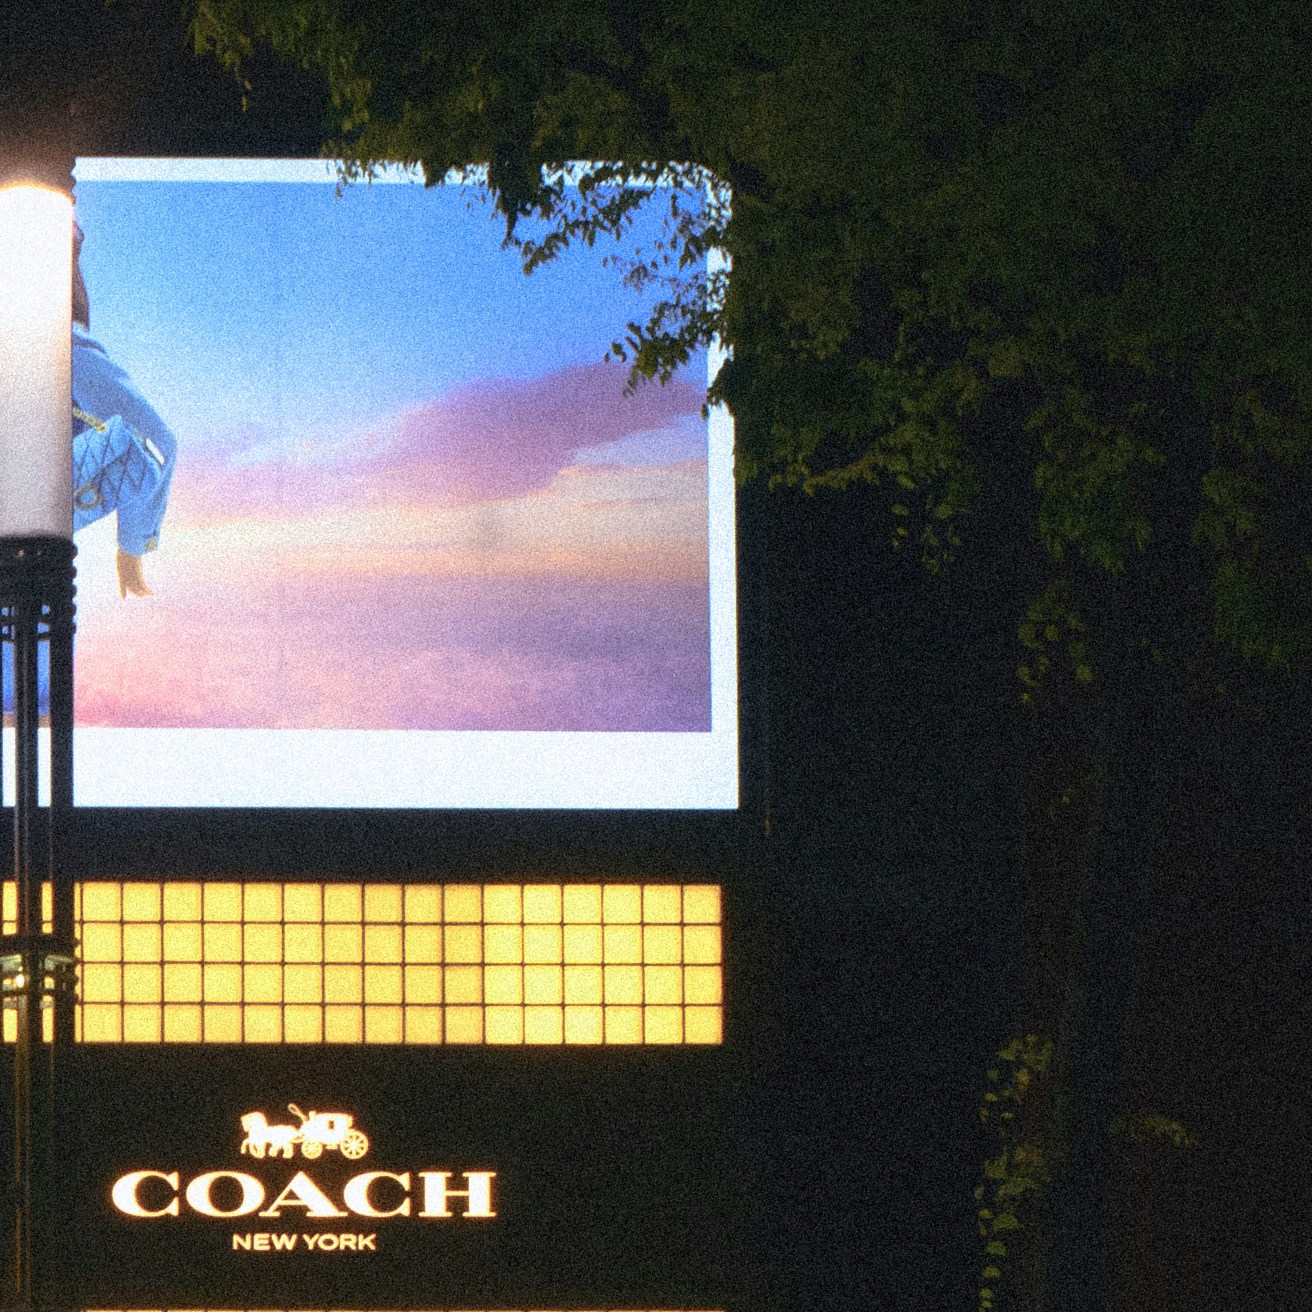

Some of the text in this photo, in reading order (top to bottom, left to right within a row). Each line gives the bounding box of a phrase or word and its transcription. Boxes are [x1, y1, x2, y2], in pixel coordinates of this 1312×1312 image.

[111, 1170, 497, 1219] COACH
[233, 1233, 377, 1252] NEW YORK
